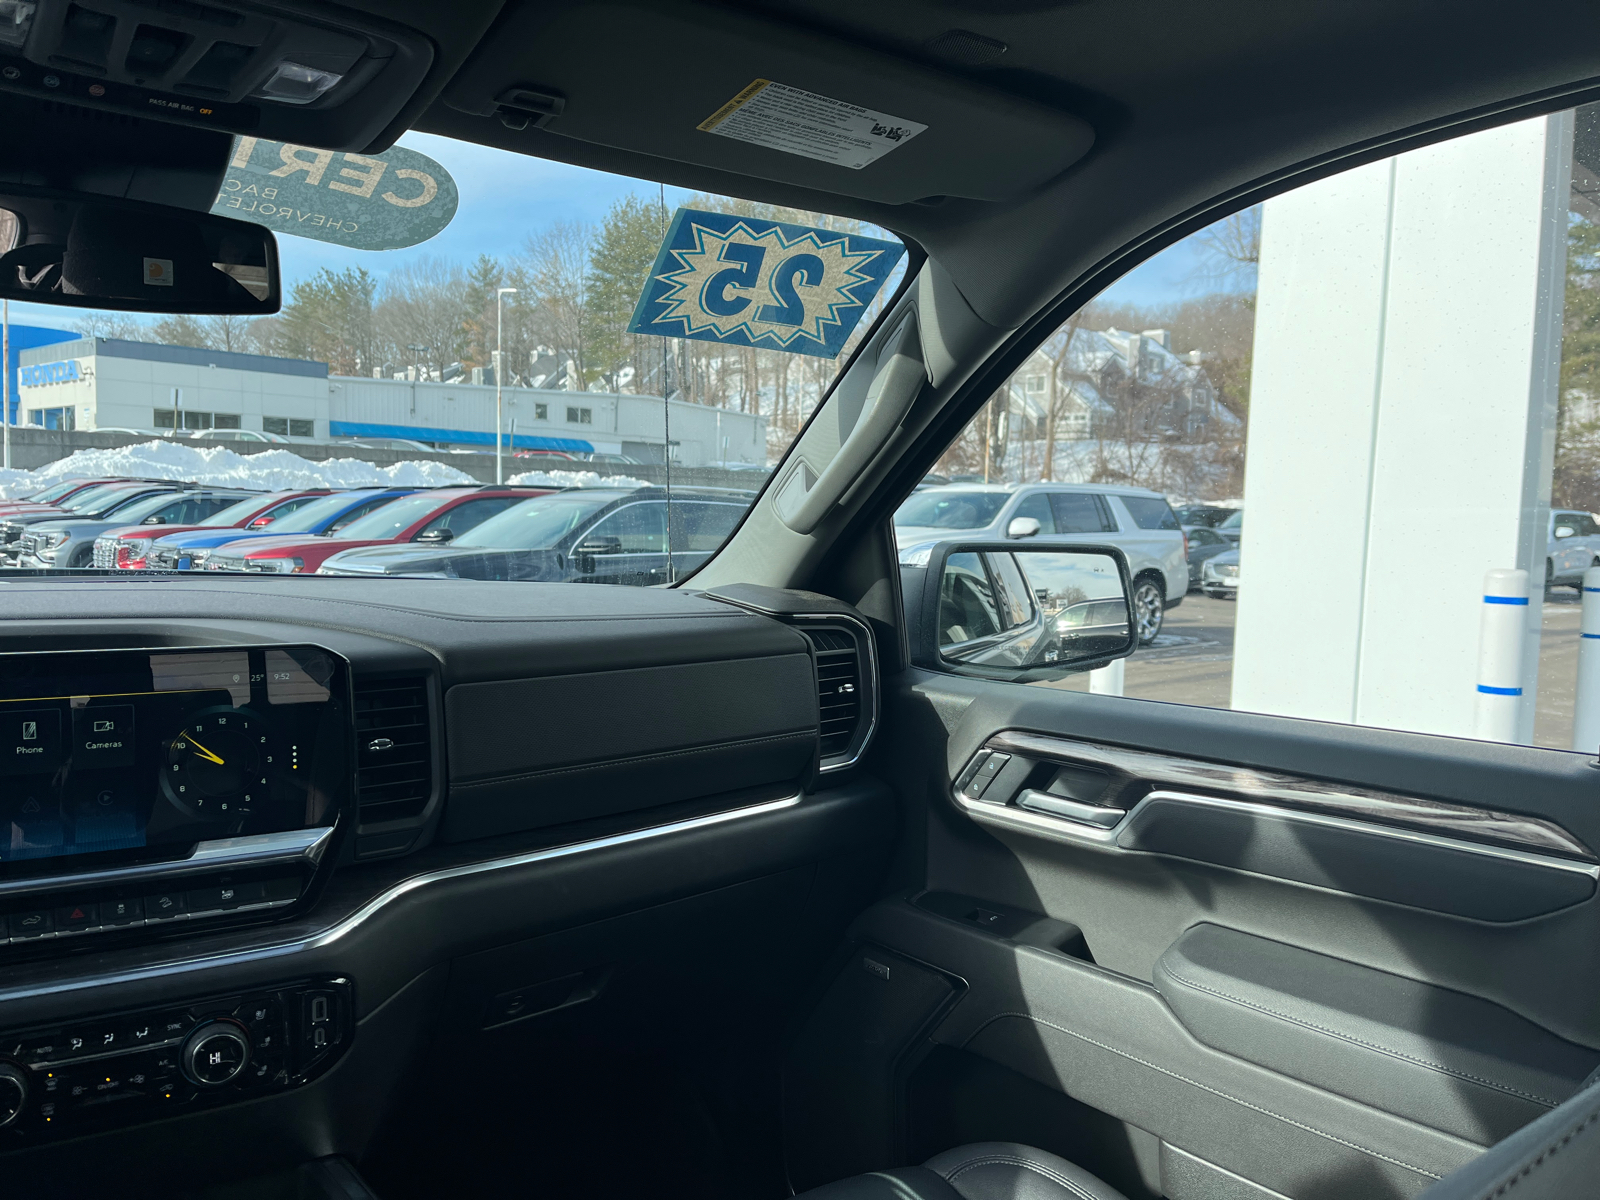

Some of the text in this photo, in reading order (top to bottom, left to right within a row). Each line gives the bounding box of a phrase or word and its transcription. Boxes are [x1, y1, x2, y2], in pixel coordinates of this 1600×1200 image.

[769, 82, 788, 90] EVEN
[787, 87, 805, 95] WITH
[804, 92, 839, 105] ADVANCED
[149, 98, 167, 106] PASS
[181, 104, 194, 112] BAG
[199, 108, 213, 116] OFF
[20, 360, 79, 387] HONDA
[16, 745, 44, 755] Phone
[85, 740, 123, 750] Cameras
[166, 1022, 182, 1031] SYNC
[209, 1051, 221, 1065] HI
